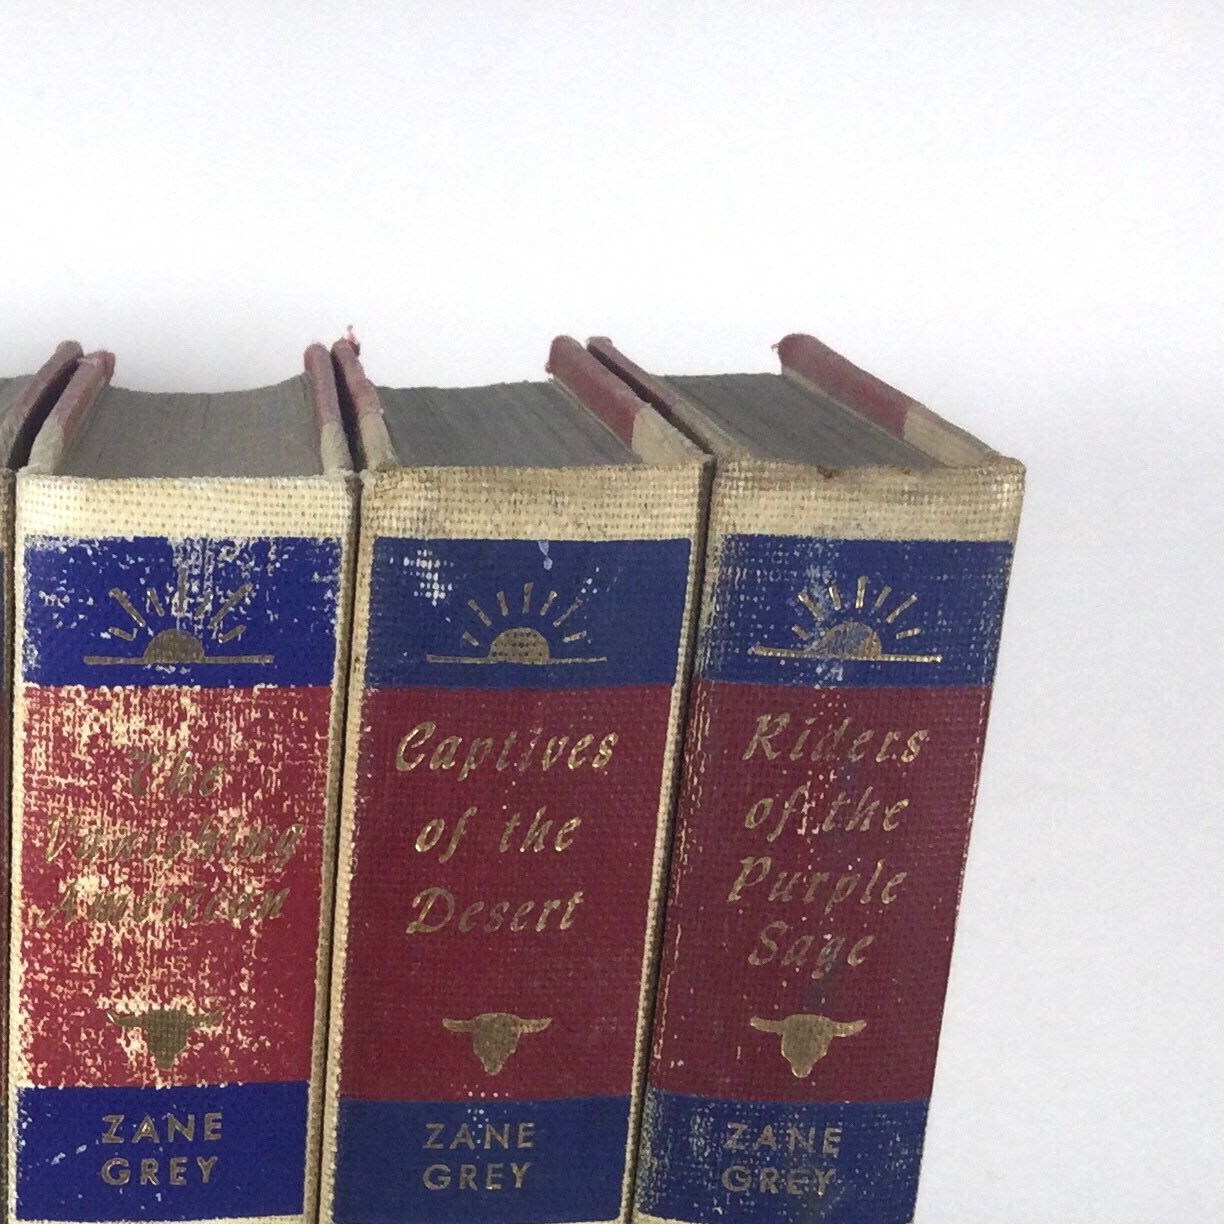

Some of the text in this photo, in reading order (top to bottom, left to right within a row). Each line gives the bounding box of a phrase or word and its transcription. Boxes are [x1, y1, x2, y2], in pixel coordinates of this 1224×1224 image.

[395, 721, 618, 783] Captives
[742, 712, 929, 763] Riders
[130, 749, 224, 797] The
[414, 807, 582, 863] of the
[745, 786, 909, 841] of the
[727, 856, 908, 913] Purple
[406, 886, 584, 934] Desert
[748, 922, 874, 979] Sage
[102, 1112, 223, 1144] ZANE
[423, 1123, 536, 1150] ZANE
[726, 1123, 842, 1154] ZANE
[102, 1157, 219, 1186] GREY
[423, 1163, 531, 1191] GREY
[722, 1165, 834, 1197] GREY
